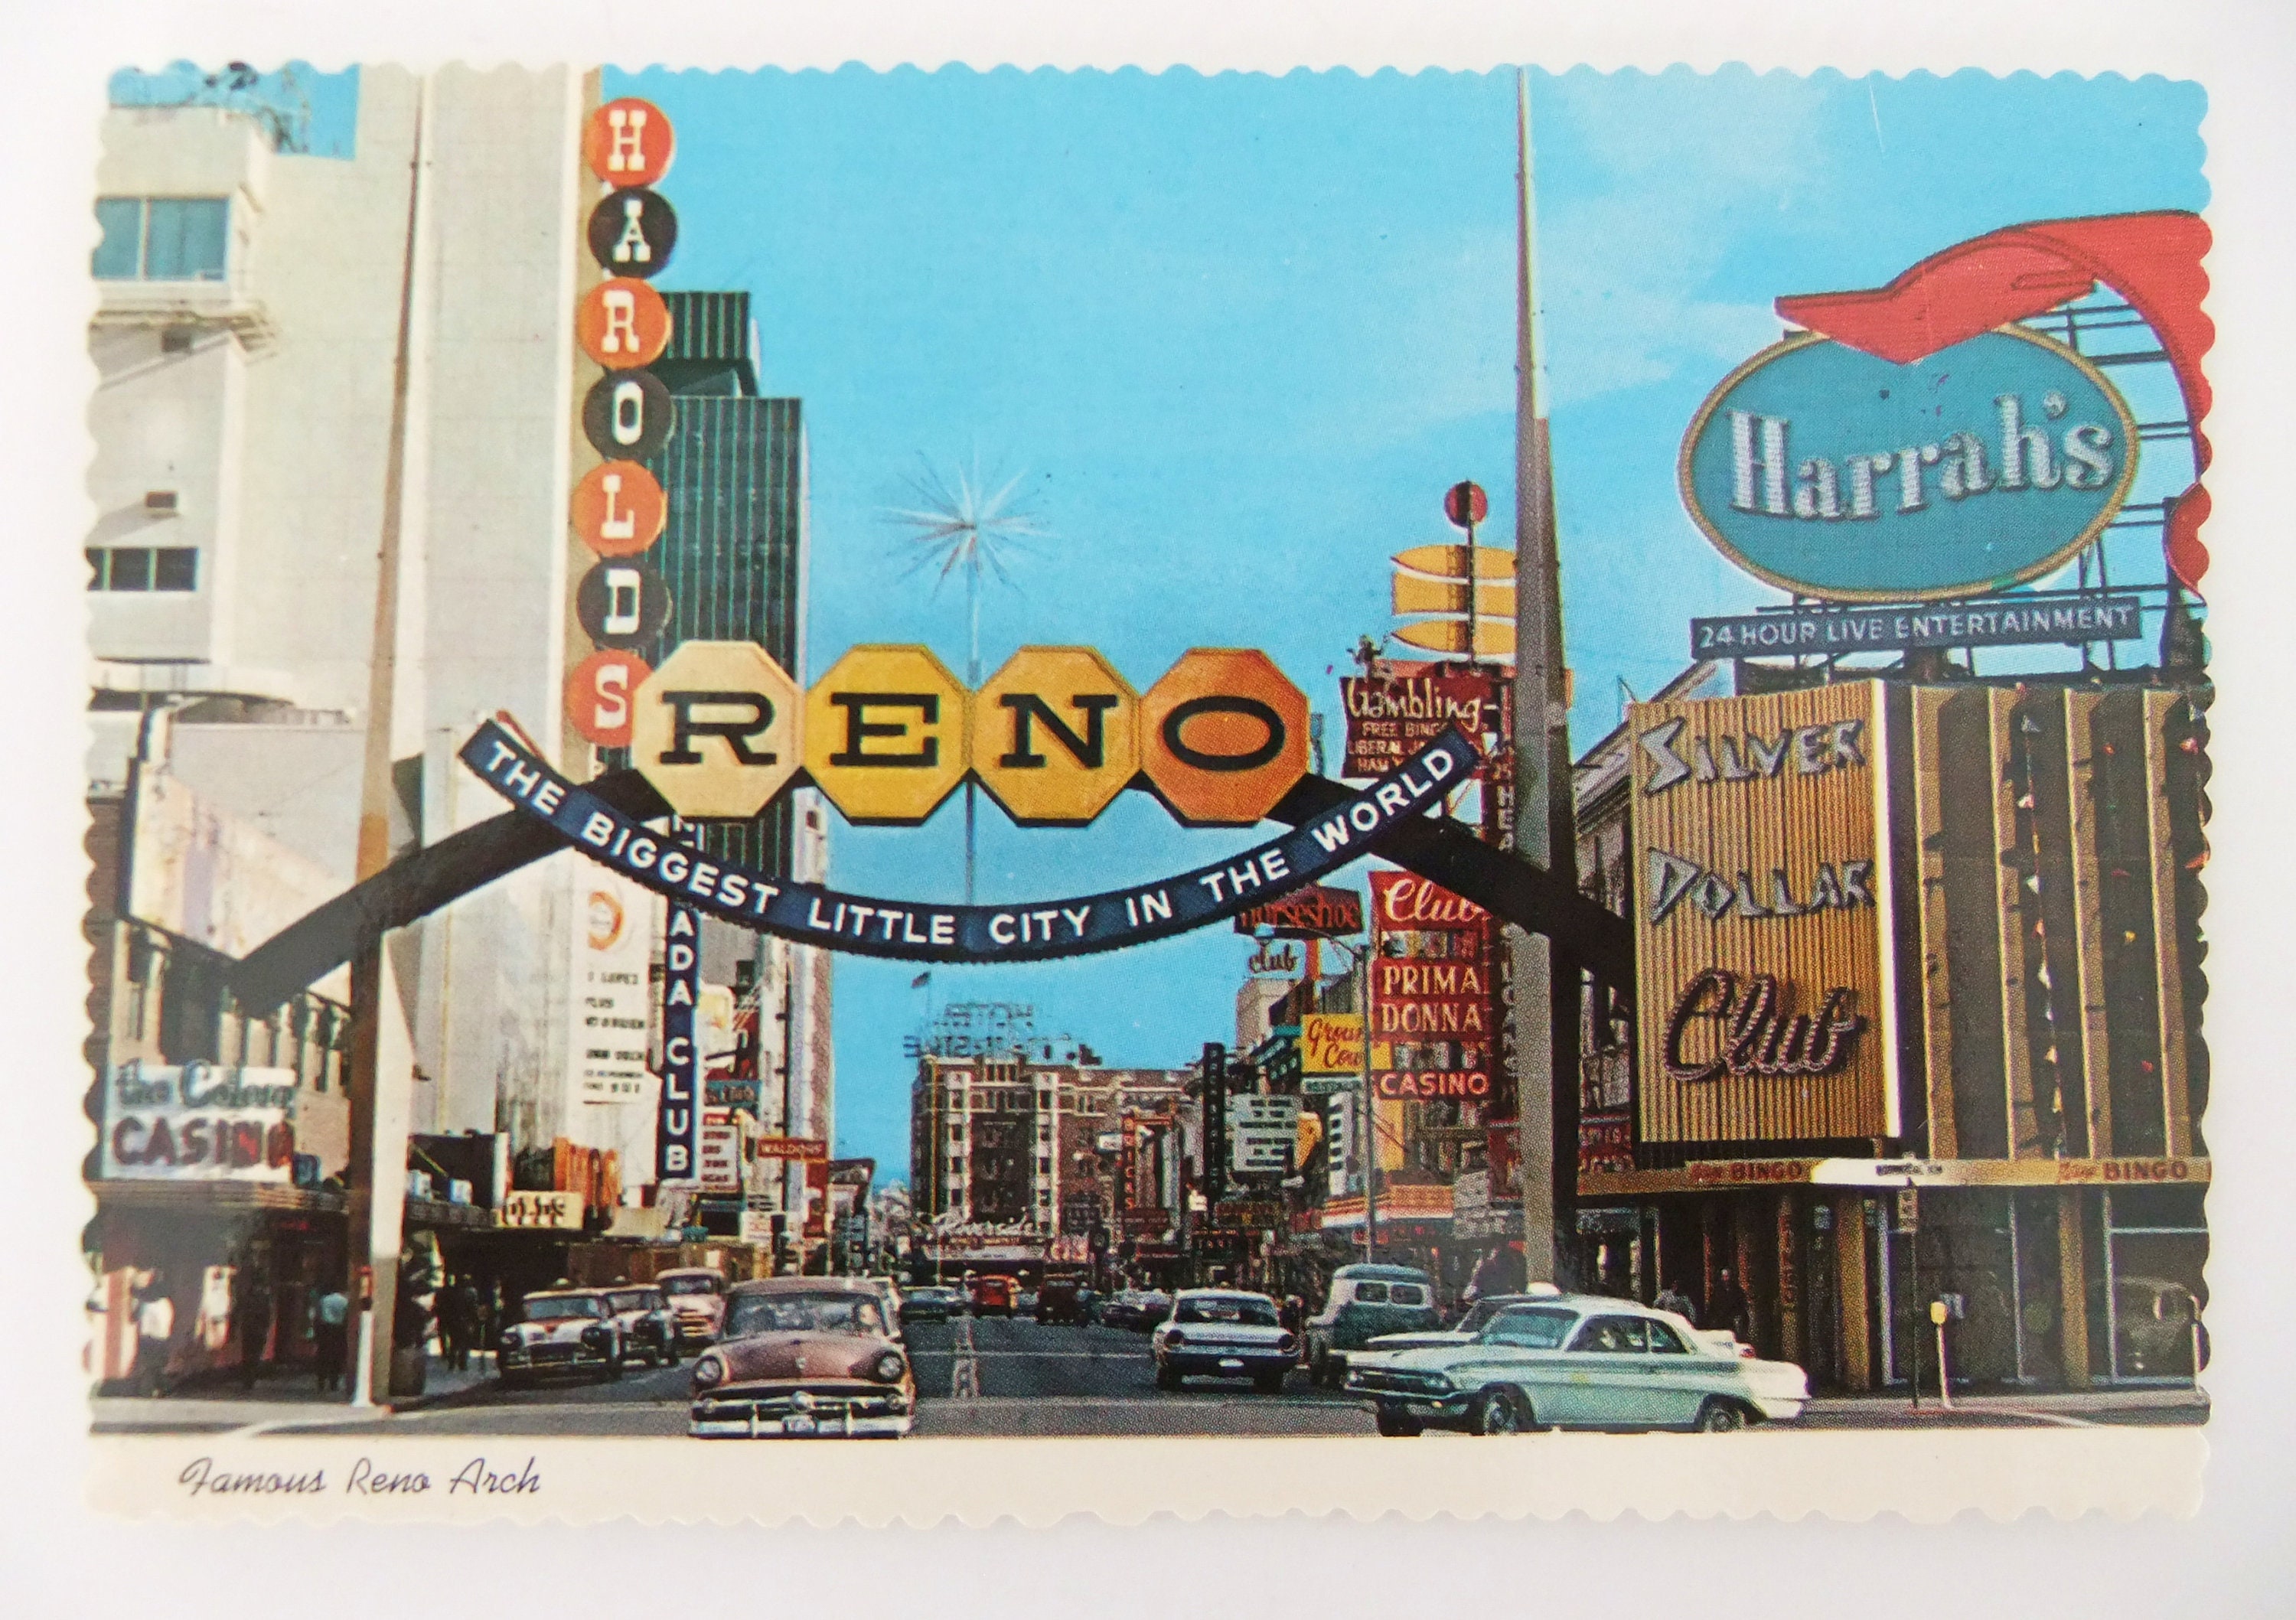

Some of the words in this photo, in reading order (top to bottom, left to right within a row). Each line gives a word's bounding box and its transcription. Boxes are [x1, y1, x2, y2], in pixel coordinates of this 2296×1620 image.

[595, 109, 651, 730] HAROLDS
[1726, 391, 2115, 523] Harrah's
[1698, 627, 1733, 649] 24
[1743, 621, 1815, 646] HOUR
[1826, 618, 1883, 641] LIVE
[1895, 607, 2133, 639] ENTERTAINMENT
[659, 690, 1285, 773] RENO
[1642, 715, 1866, 795] SILVER
[487, 740, 567, 817] THE
[580, 811, 781, 915] BIGGEST
[806, 897, 956, 946] LITTLE
[988, 905, 1092, 947] CITY
[1125, 889, 1174, 927] IN
[1200, 846, 1291, 905] THE
[1309, 748, 1456, 855] WORLD
[1648, 847, 1877, 925] DOLLAR
[1383, 966, 1481, 995] PRIMA
[1381, 1002, 1483, 1032] DONNA
[1664, 968, 1868, 1082] Club
[664, 1036, 690, 1171] CLUB
[1380, 1072, 1490, 1097] CASINO
[113, 1116, 296, 1170] CASINO
[1730, 1161, 1803, 1181] BINGO
[2102, 1160, 2189, 1182] BINGO
[178, 1457, 328, 1496] Famous
[346, 1457, 432, 1495] Reno
[449, 1456, 541, 1495] Arch
